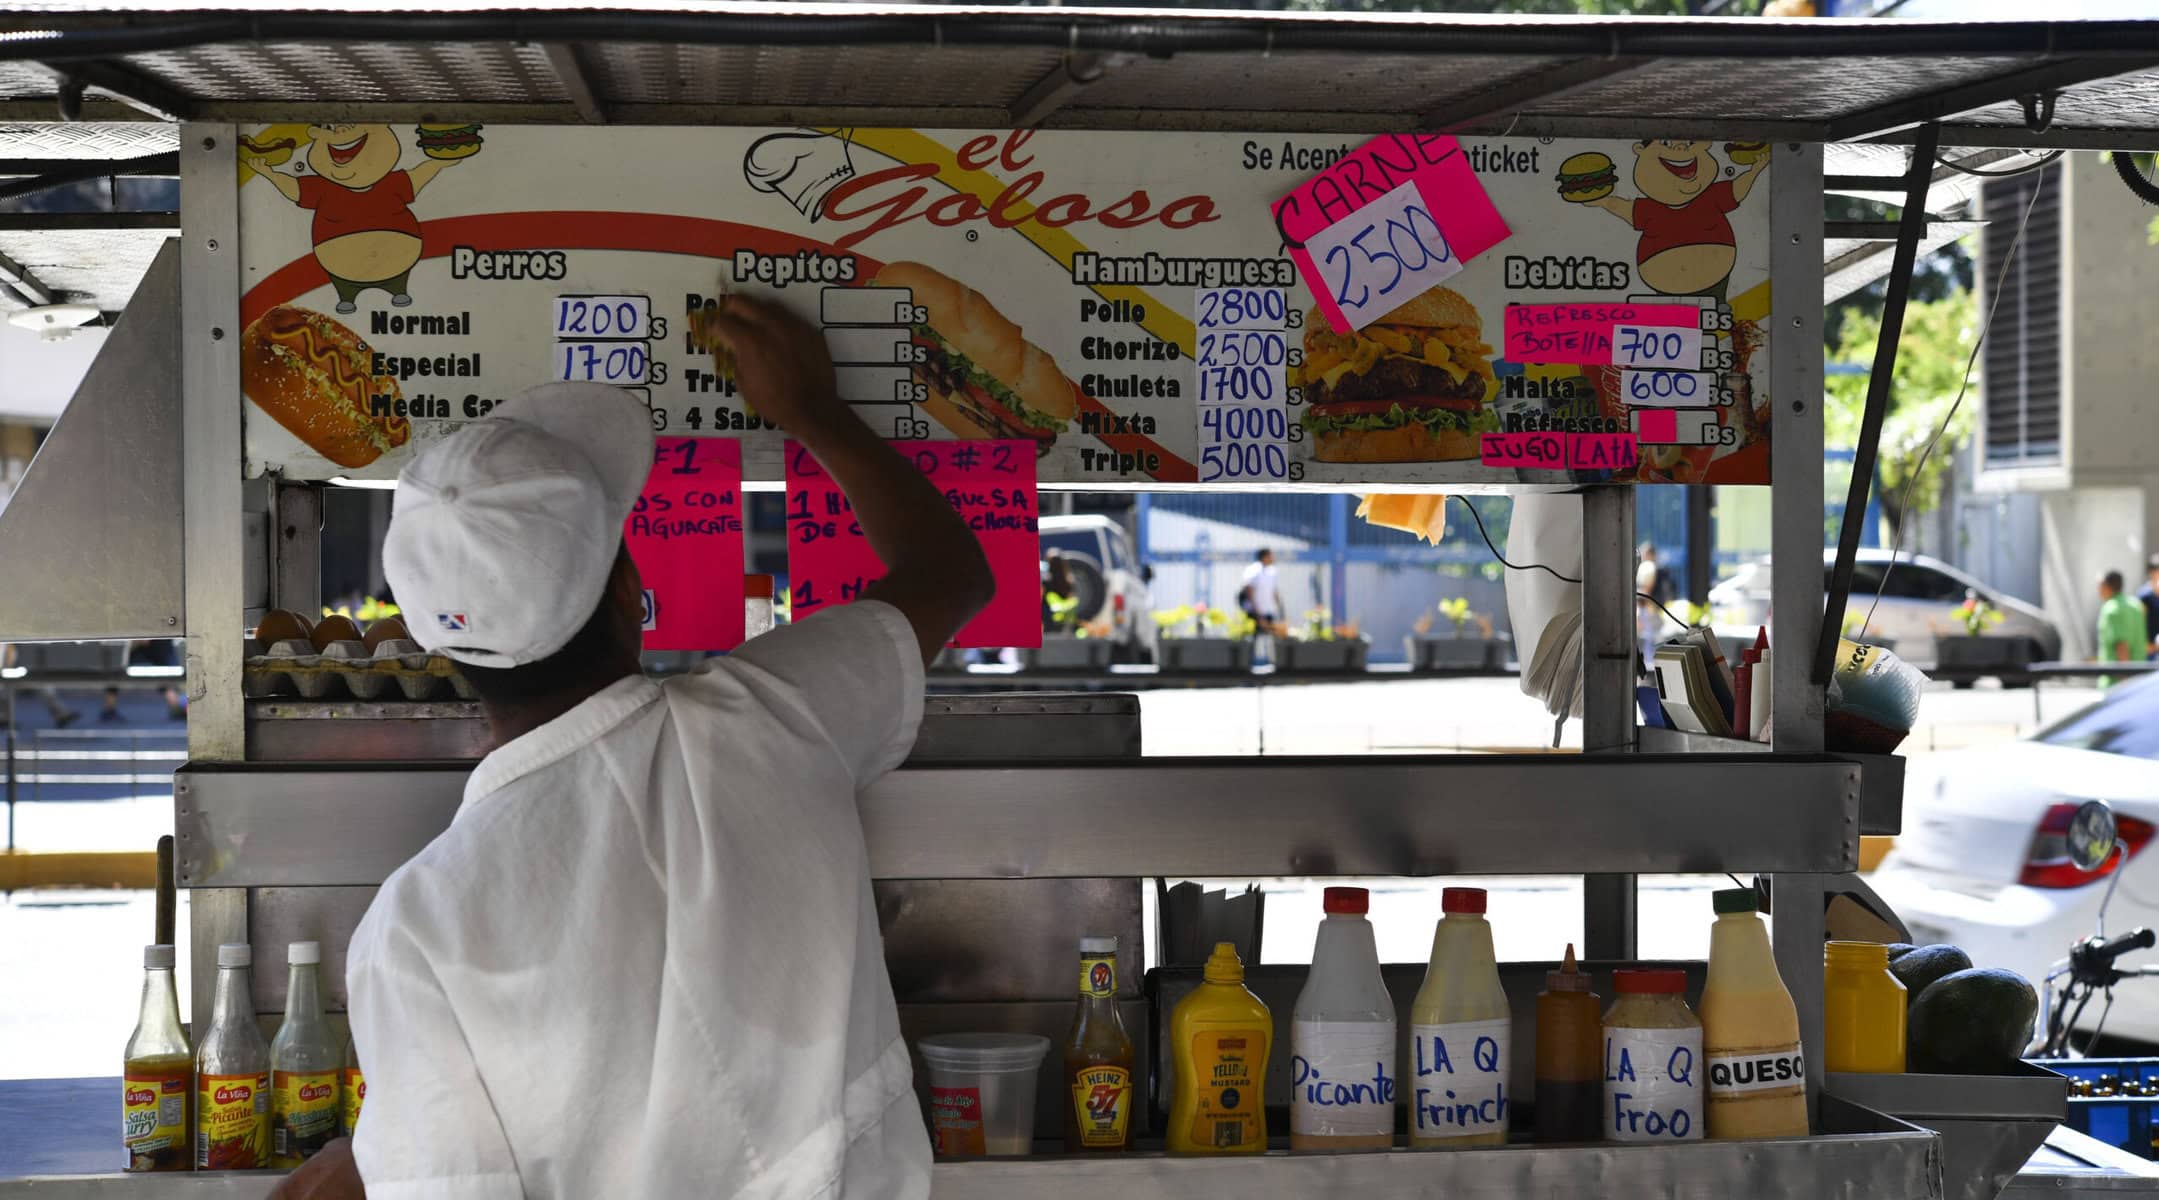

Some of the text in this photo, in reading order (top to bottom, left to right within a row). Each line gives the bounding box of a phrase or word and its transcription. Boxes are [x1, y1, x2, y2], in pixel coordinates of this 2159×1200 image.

[957, 128, 1035, 171] el
[1242, 141, 1273, 170] Se
[1465, 145, 1540, 173] ticket
[1275, 132, 1459, 250] CARNE
[822, 163, 1221, 248] Goloso
[452, 245, 567, 280] Perros
[733, 248, 856, 287] Pepitos
[1072, 252, 1296, 288] Hamburguesa
[1326, 204, 1450, 309] 2500
[1504, 256, 1630, 290] Bebidas
[558, 301, 637, 334] 1200
[895, 302, 929, 325] Bs
[1080, 298, 1146, 324] Pollo
[1199, 289, 1284, 327] 2800
[1510, 307, 1637, 326] REFRESCO
[1700, 309, 1733, 331] Bs
[371, 310, 470, 335] Normal
[564, 345, 645, 380] 1700
[895, 341, 929, 364] Bs
[1080, 336, 1181, 361] Chorizo
[1199, 332, 1285, 366] 2500
[1621, 328, 1733, 370] 700 Bs
[371, 353, 481, 381] Especial
[895, 379, 929, 402] Bs
[1080, 373, 1181, 398] Chuleta
[1200, 366, 1272, 400] 1700
[1505, 375, 1575, 399] Malta
[1631, 370, 1697, 400] 600
[371, 394, 450, 418] Media
[686, 407, 702, 430] 4
[895, 417, 930, 439] Bs
[1081, 412, 1157, 435] Mixta
[1203, 407, 1285, 442] 4000
[1506, 412, 1617, 433] Refresco
[1702, 423, 1736, 446] Bs
[1080, 448, 1159, 477] Triple
[1202, 443, 1287, 482] 5000
[1483, 436, 1560, 462] JUGO
[684, 490, 734, 508] CON
[632, 515, 743, 539] AGUACATE
[794, 521, 837, 543] DE
[1416, 1036, 1499, 1077] LA Q
[1605, 1037, 1693, 1087] LA Q
[1087, 1072, 1121, 1086] HEINZ
[1210, 1079, 1251, 1087] MUSTARD
[1291, 1055, 1395, 1106] Picante
[217, 1090, 228, 1099] La
[1086, 1084, 1123, 1113] 57
[1416, 1083, 1511, 1129] Frinch
[128, 1111, 157, 1123] Salsa
